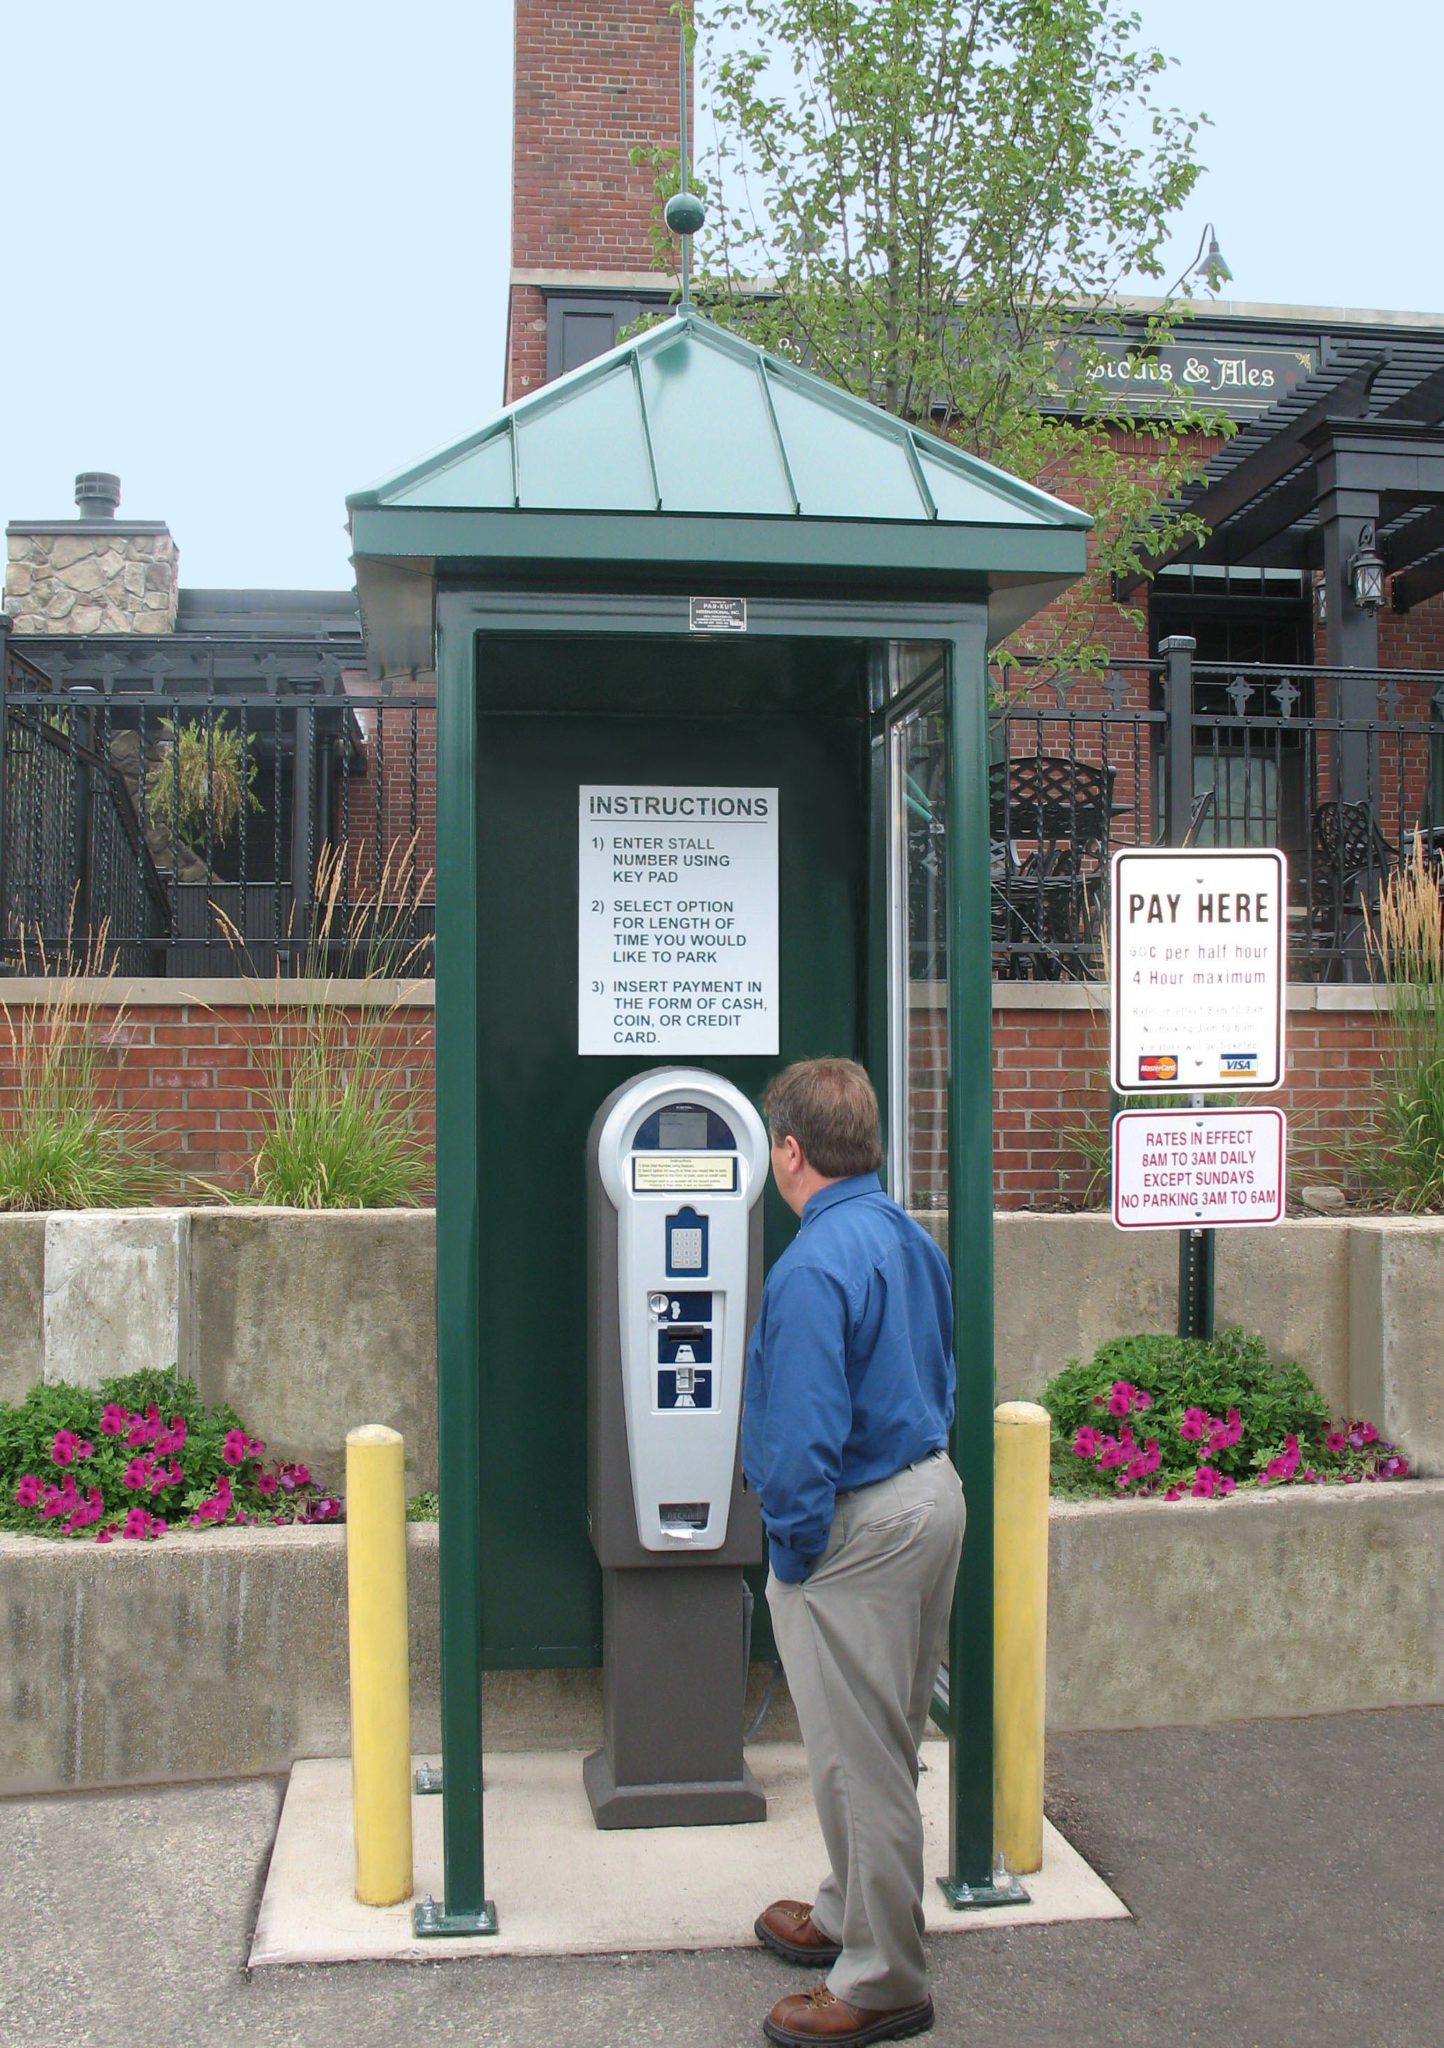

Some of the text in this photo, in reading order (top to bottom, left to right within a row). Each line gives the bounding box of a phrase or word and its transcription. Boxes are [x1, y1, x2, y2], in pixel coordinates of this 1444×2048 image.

[1182, 357, 1211, 384] &
[1211, 357, 1275, 391] Ales
[589, 796, 768, 816] INSTRUCTIONS
[592, 837, 715, 851] 1) ENTER STALL
[613, 854, 730, 867] NUMBER USING
[613, 871, 678, 883] KEY PAD
[592, 900, 734, 914] 2) SELECT OPTION
[1129, 893, 1269, 924] PAY HERE
[613, 917, 735, 929] FOR LENGTH OF
[614, 934, 746, 946] TIME YOU WOULD
[613, 951, 718, 963] LIKE TO PARK
[1166, 947, 1189, 961] per
[1198, 944, 1227, 959] half
[1235, 944, 1268, 959] hour
[1132, 968, 1266, 985] 4 Hour maximum
[592, 981, 762, 995] 3) INSERT PAYMENT IN
[614, 998, 768, 1012] THE FORM OF CASH,
[613, 1014, 742, 1028] COIN, OR CREDIT
[613, 1031, 661, 1043] CARD.
[1226, 1060, 1251, 1070] VISA
[1146, 1130, 1253, 1147] RATES IN EFFECT
[1142, 1150, 1256, 1167] 8AM TO 3AM DAILY
[1144, 1170, 1254, 1187] EXCEPT SUNDAYS
[1121, 1190, 1276, 1208] NO PARKING 3AM TO 6AM
